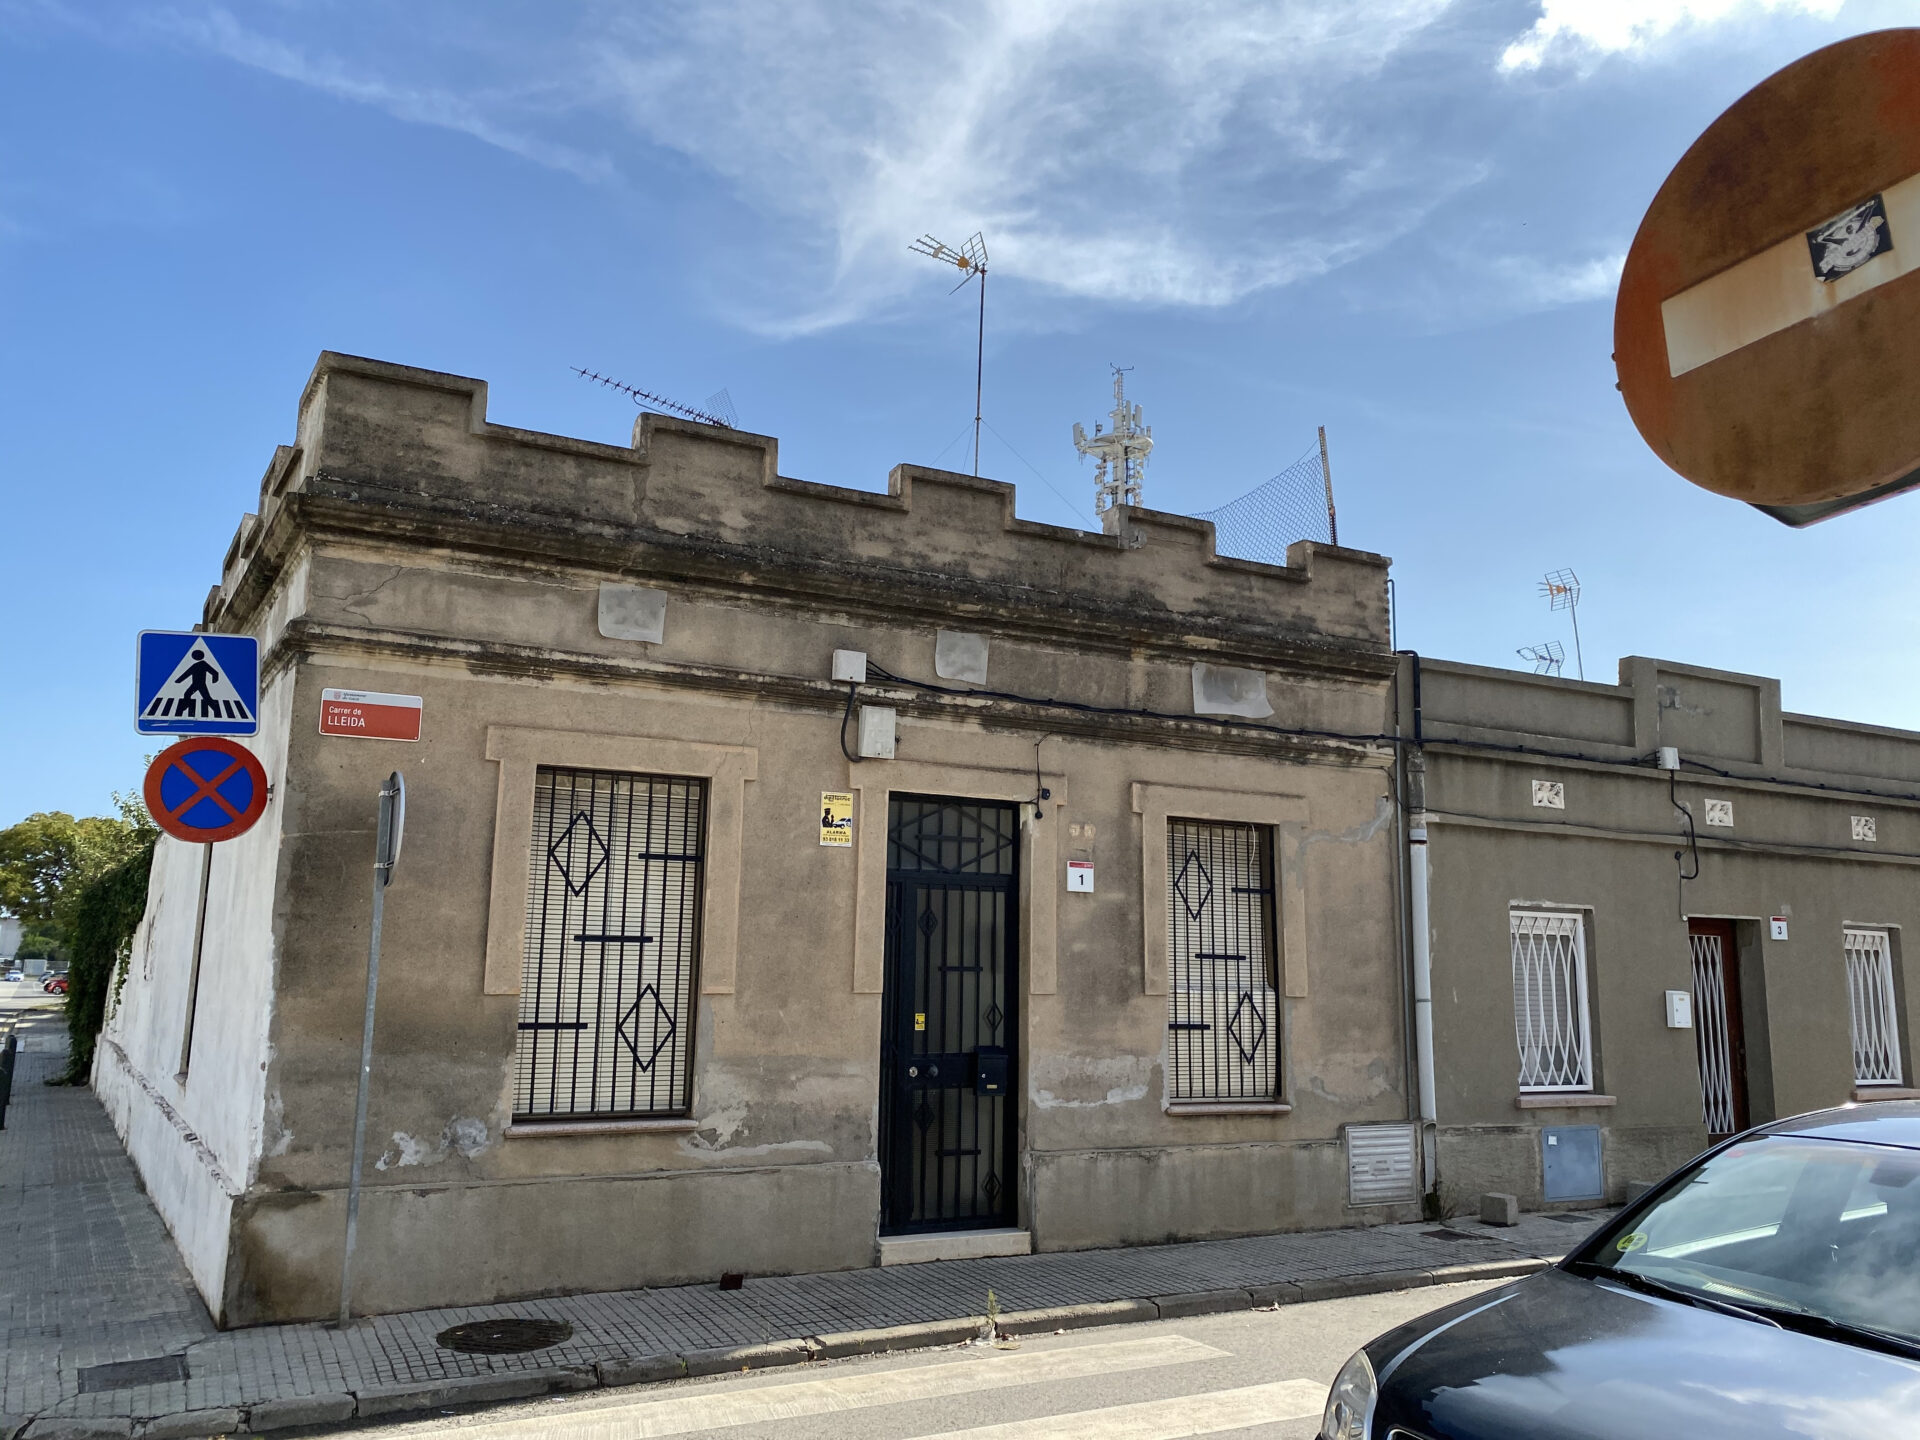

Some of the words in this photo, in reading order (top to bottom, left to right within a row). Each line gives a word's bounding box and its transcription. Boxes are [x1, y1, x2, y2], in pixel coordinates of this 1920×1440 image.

[328, 705, 351, 715] Carrer
[352, 707, 362, 716] de
[327, 715, 366, 728] LLEIDA
[1078, 874, 1084, 886] 1
[1777, 925, 1783, 935] 3
